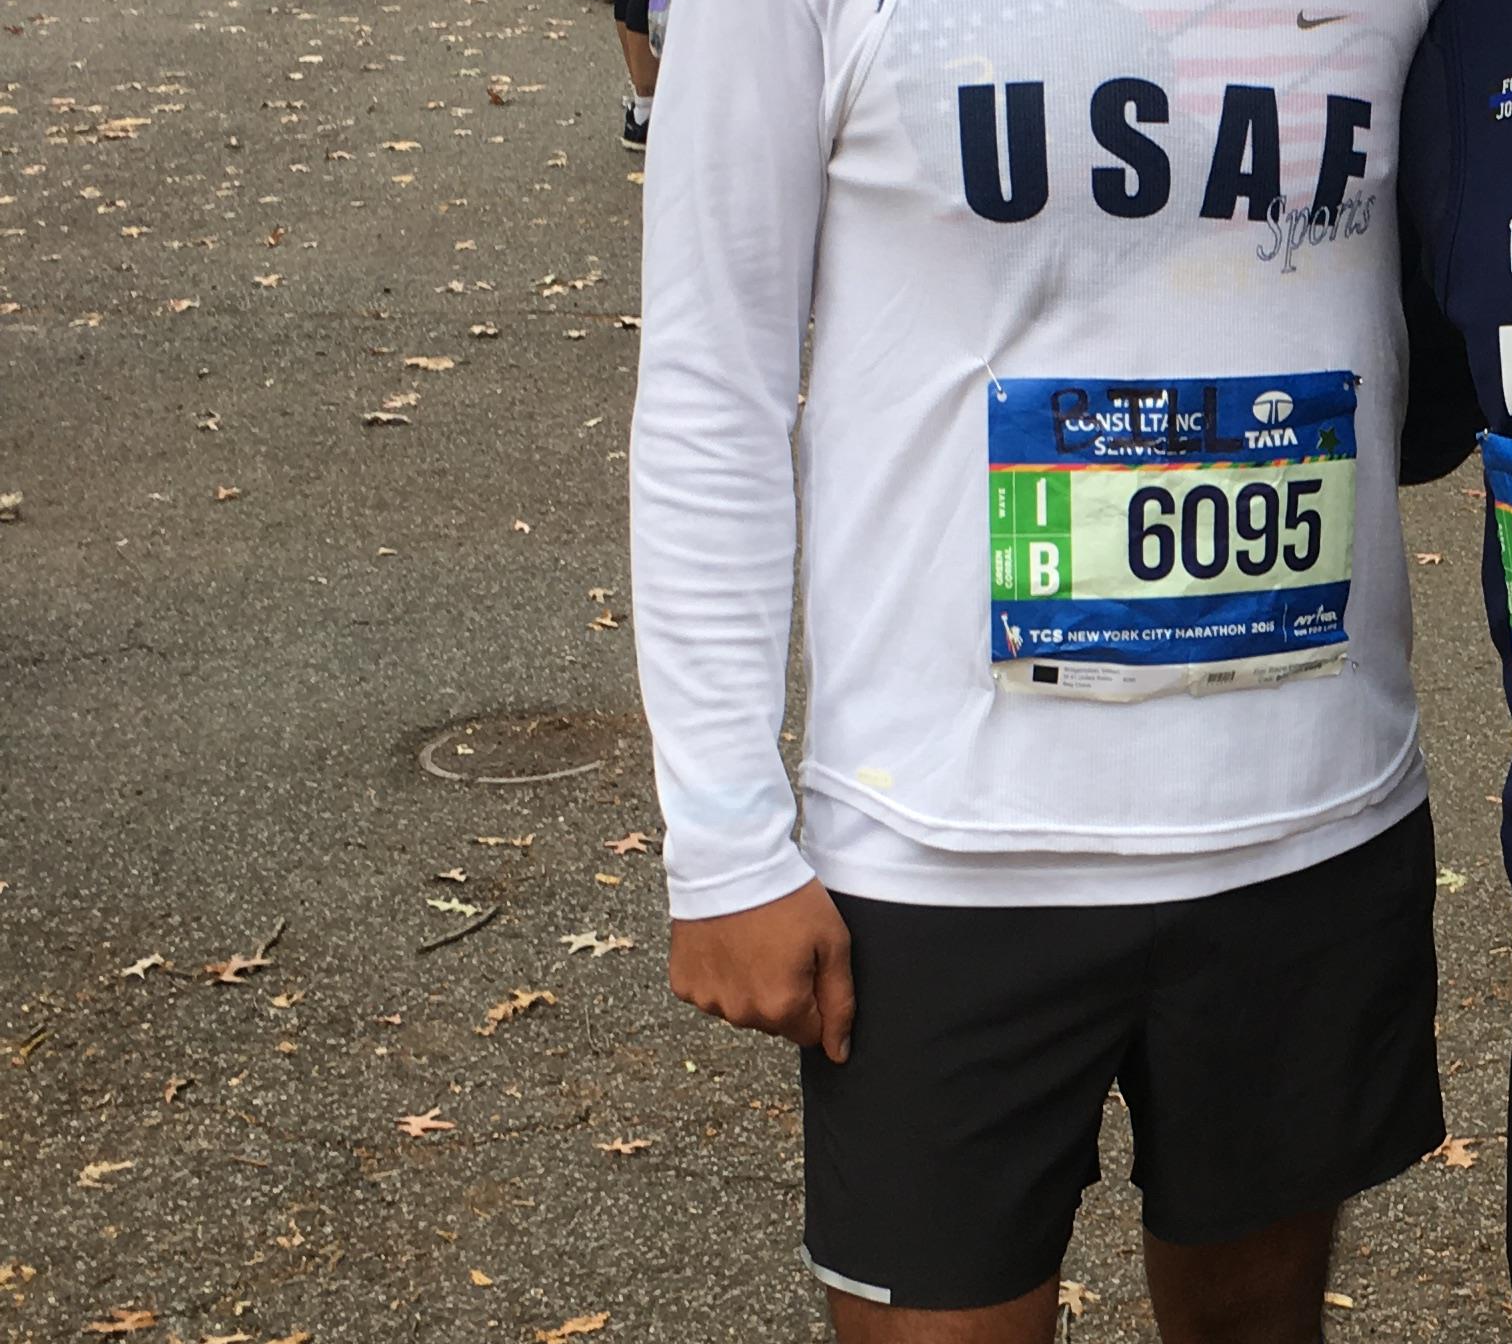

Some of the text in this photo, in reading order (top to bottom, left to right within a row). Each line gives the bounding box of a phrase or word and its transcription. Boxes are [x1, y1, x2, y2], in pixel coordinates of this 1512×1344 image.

[957, 76, 1372, 227] USAF
[1256, 191, 1376, 274] Sports
[1065, 412, 1211, 432] CONSULTANC
[1244, 427, 1298, 449] TATA
[1128, 479, 1323, 582] 6095
[1028, 541, 1060, 597] B
[1030, 629, 1064, 644] TCS
[1067, 630, 1100, 643] NEW
[1102, 629, 1139, 642] YORK
[1142, 627, 1173, 641] CITY
[1175, 623, 1247, 639] MARATHON
